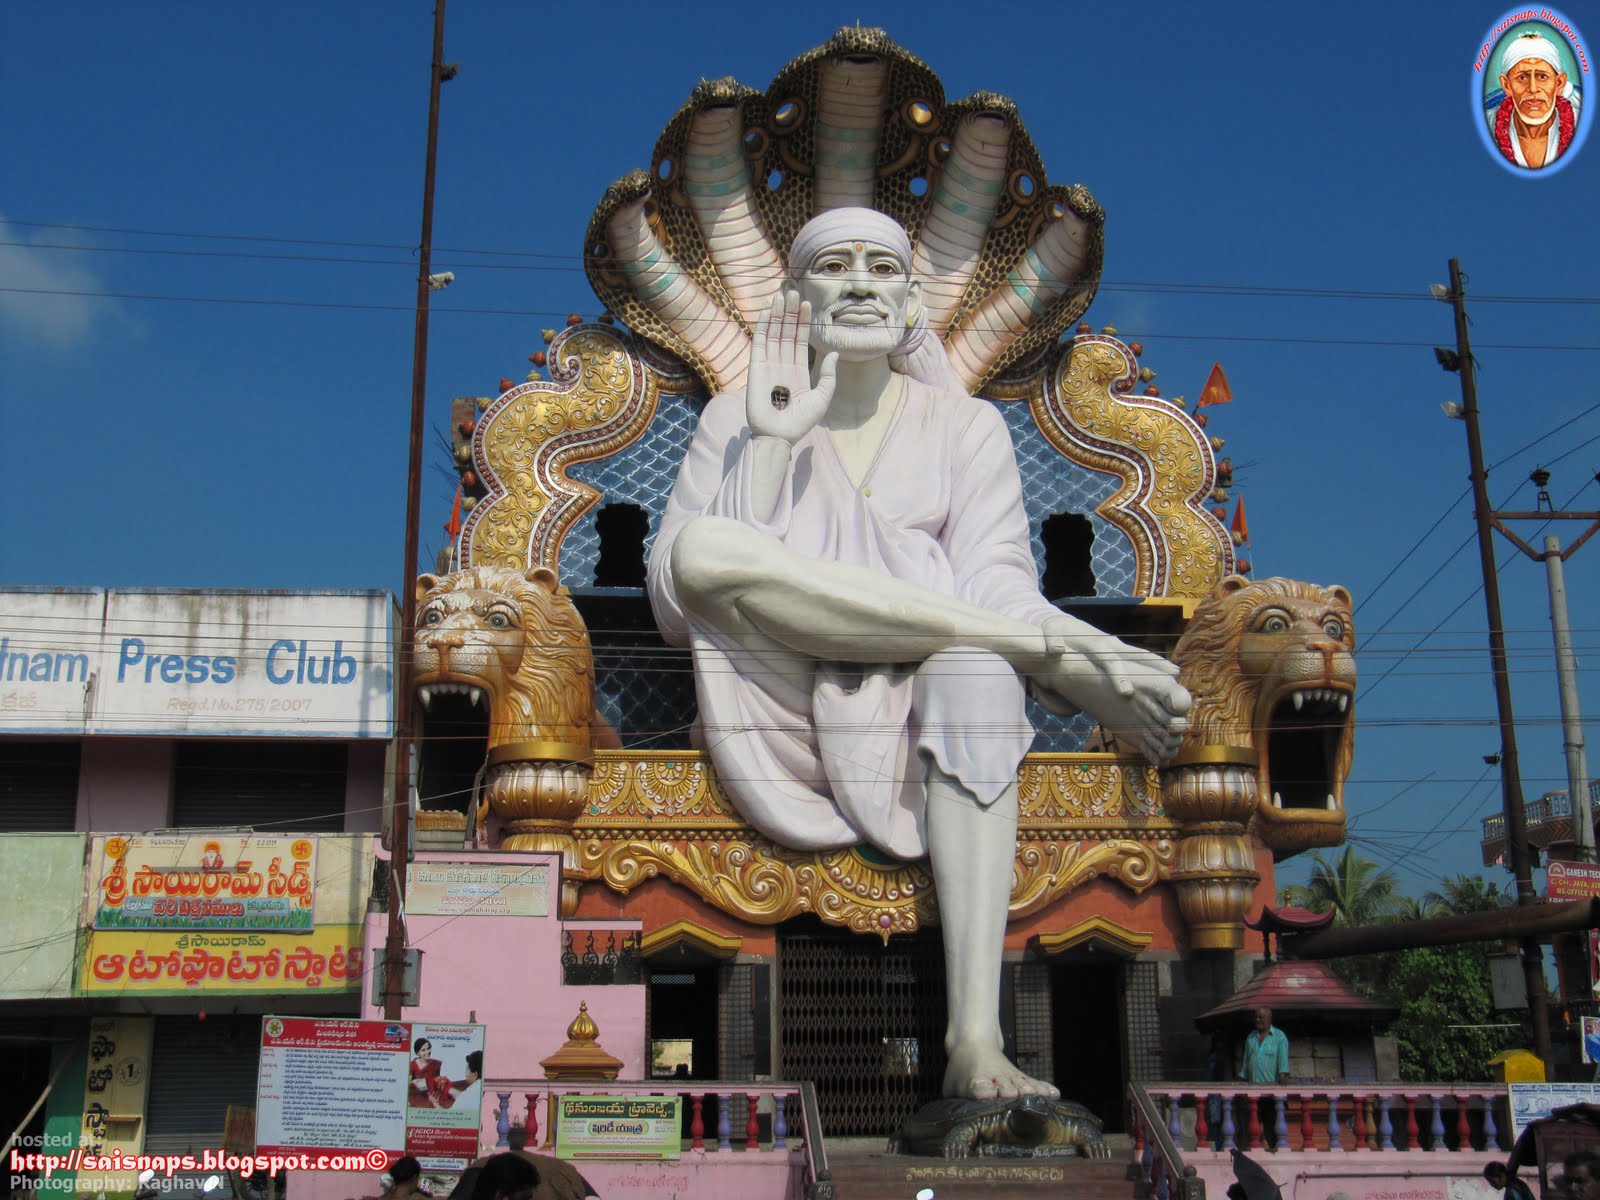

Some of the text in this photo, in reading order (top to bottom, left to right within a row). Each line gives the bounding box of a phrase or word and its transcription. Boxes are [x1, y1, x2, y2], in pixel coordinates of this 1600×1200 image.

[117, 638, 236, 684] Press
[265, 639, 357, 685] Club
[101, 856, 128, 907] శ్రీ
[1566, 868, 1588, 877] GANESH
